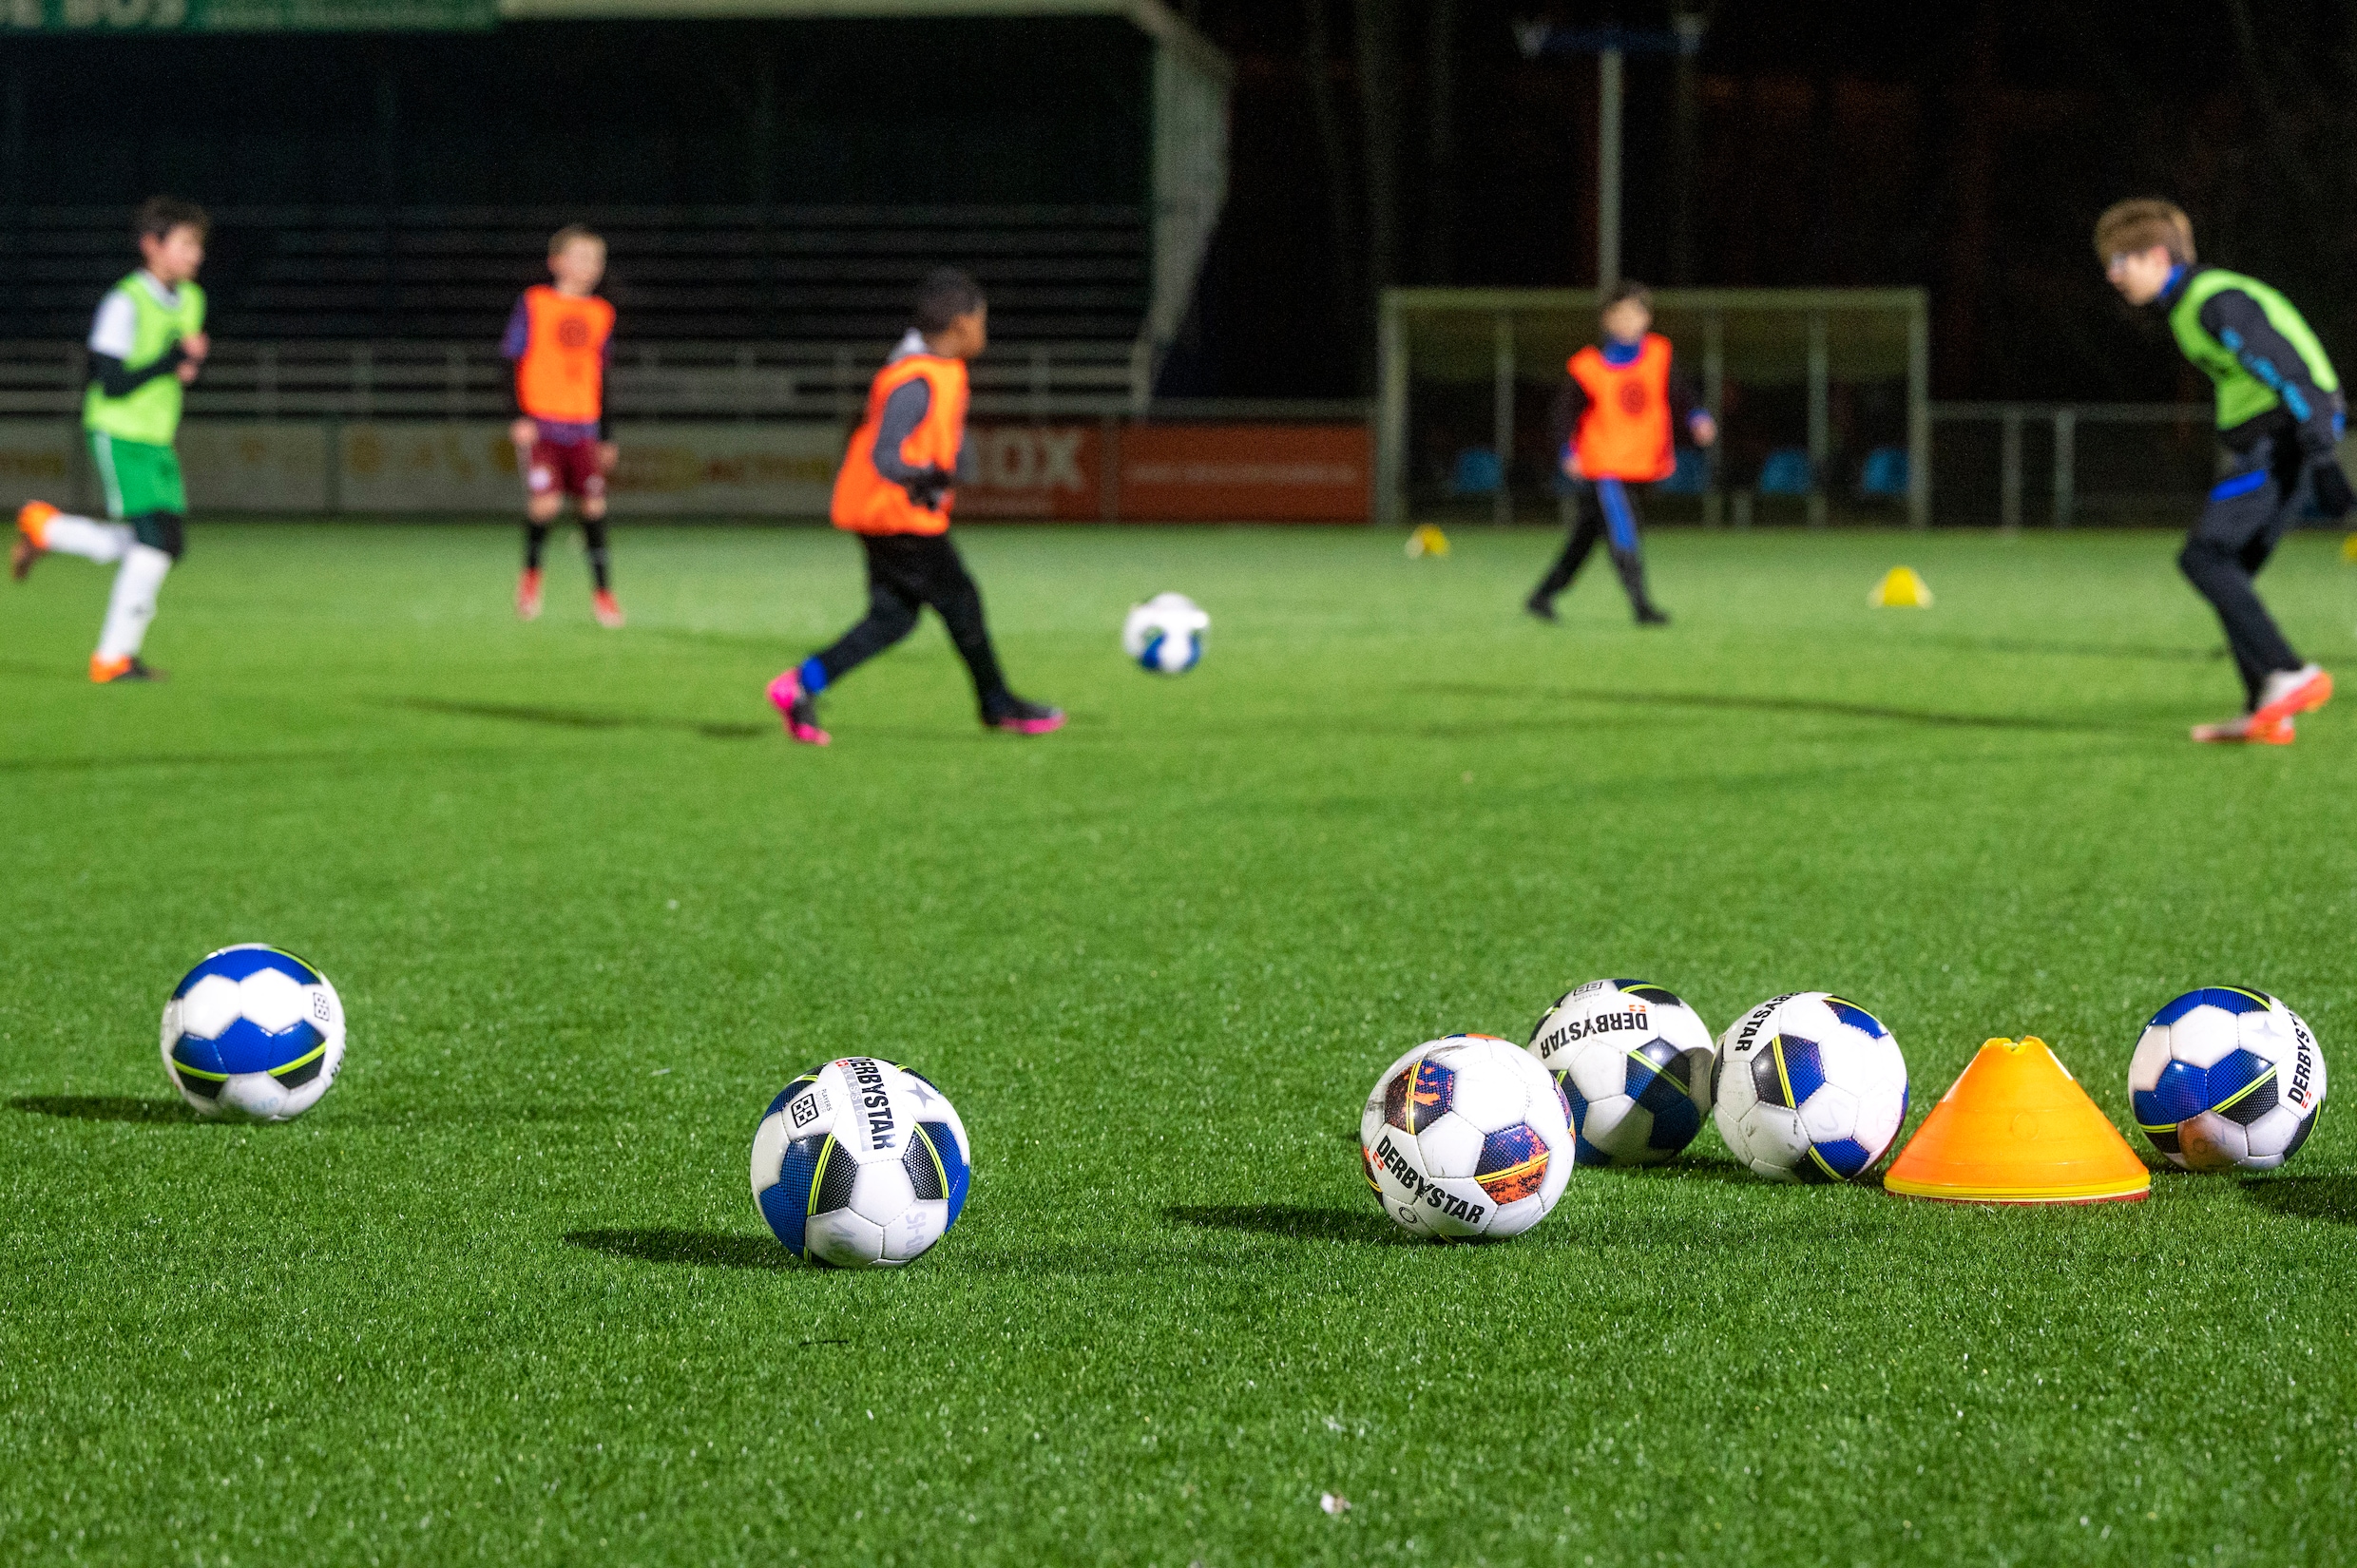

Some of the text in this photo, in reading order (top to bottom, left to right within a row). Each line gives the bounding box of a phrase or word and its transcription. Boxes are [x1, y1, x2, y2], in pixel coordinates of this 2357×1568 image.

[1540, 1012, 1649, 1060] DERBYSTAR
[821, 1088, 833, 1112] PLAYERS
[841, 1066, 867, 1116] CLASSIC
[1376, 1135, 1485, 1224] DERBYSTAR
